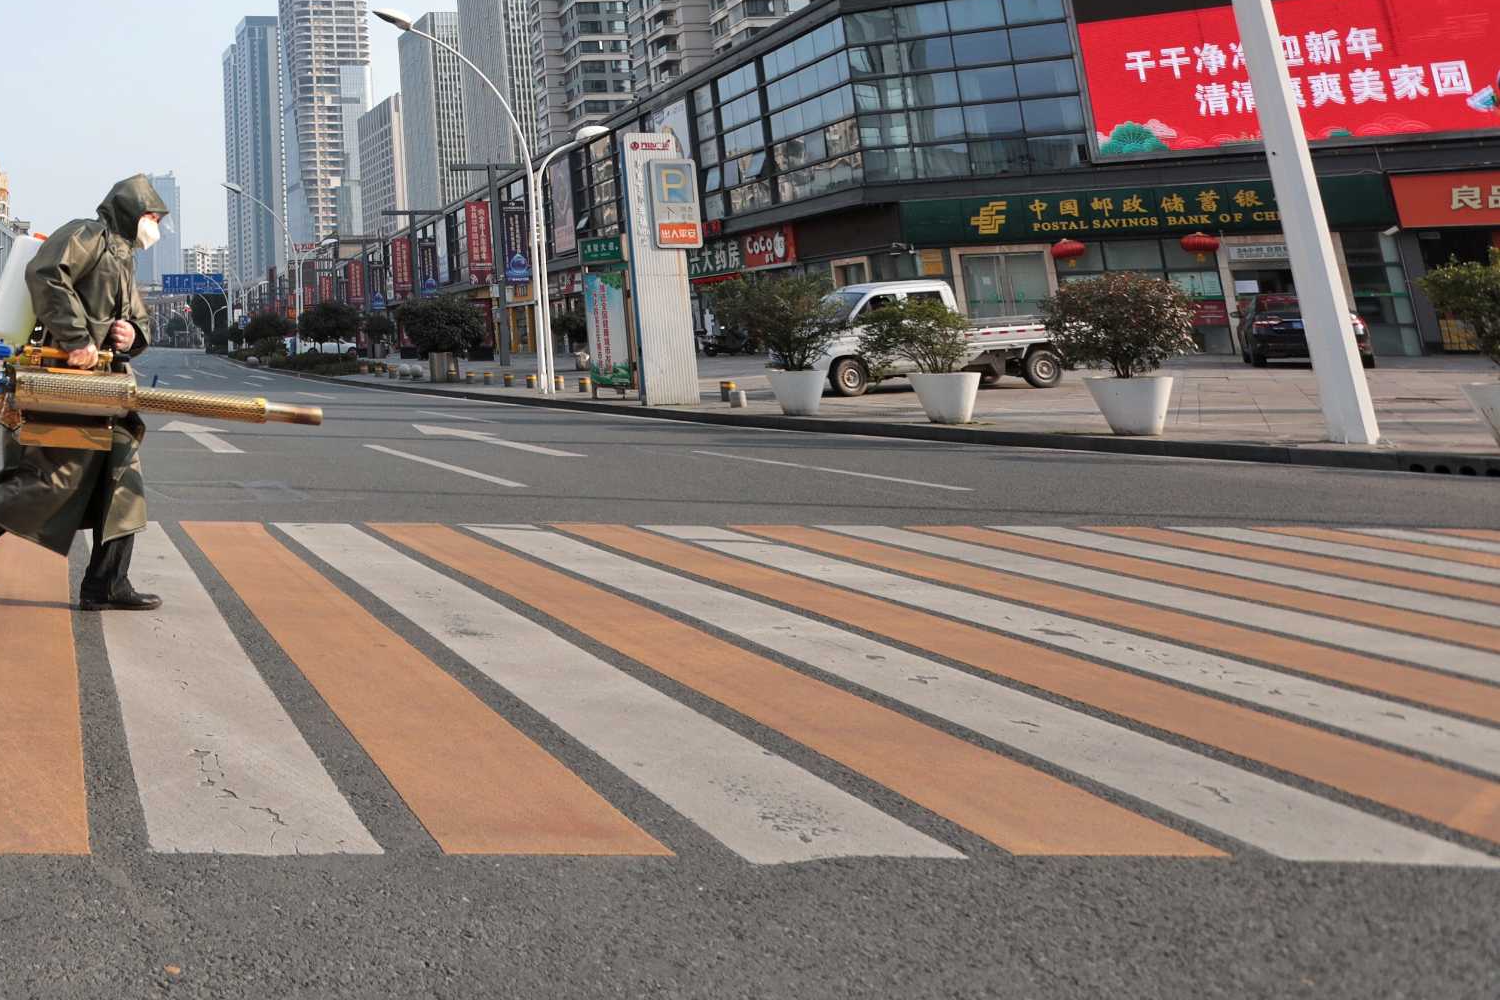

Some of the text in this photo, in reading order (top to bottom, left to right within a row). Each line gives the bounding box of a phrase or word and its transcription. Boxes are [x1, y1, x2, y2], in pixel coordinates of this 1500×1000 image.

[661, 168, 687, 201] P
[1029, 189, 1278, 220] 中国邮政储蓄银
[1032, 210, 1282, 232] POSTAL SAVINGS BANK OF CHI
[746, 235, 773, 254] CoCo
